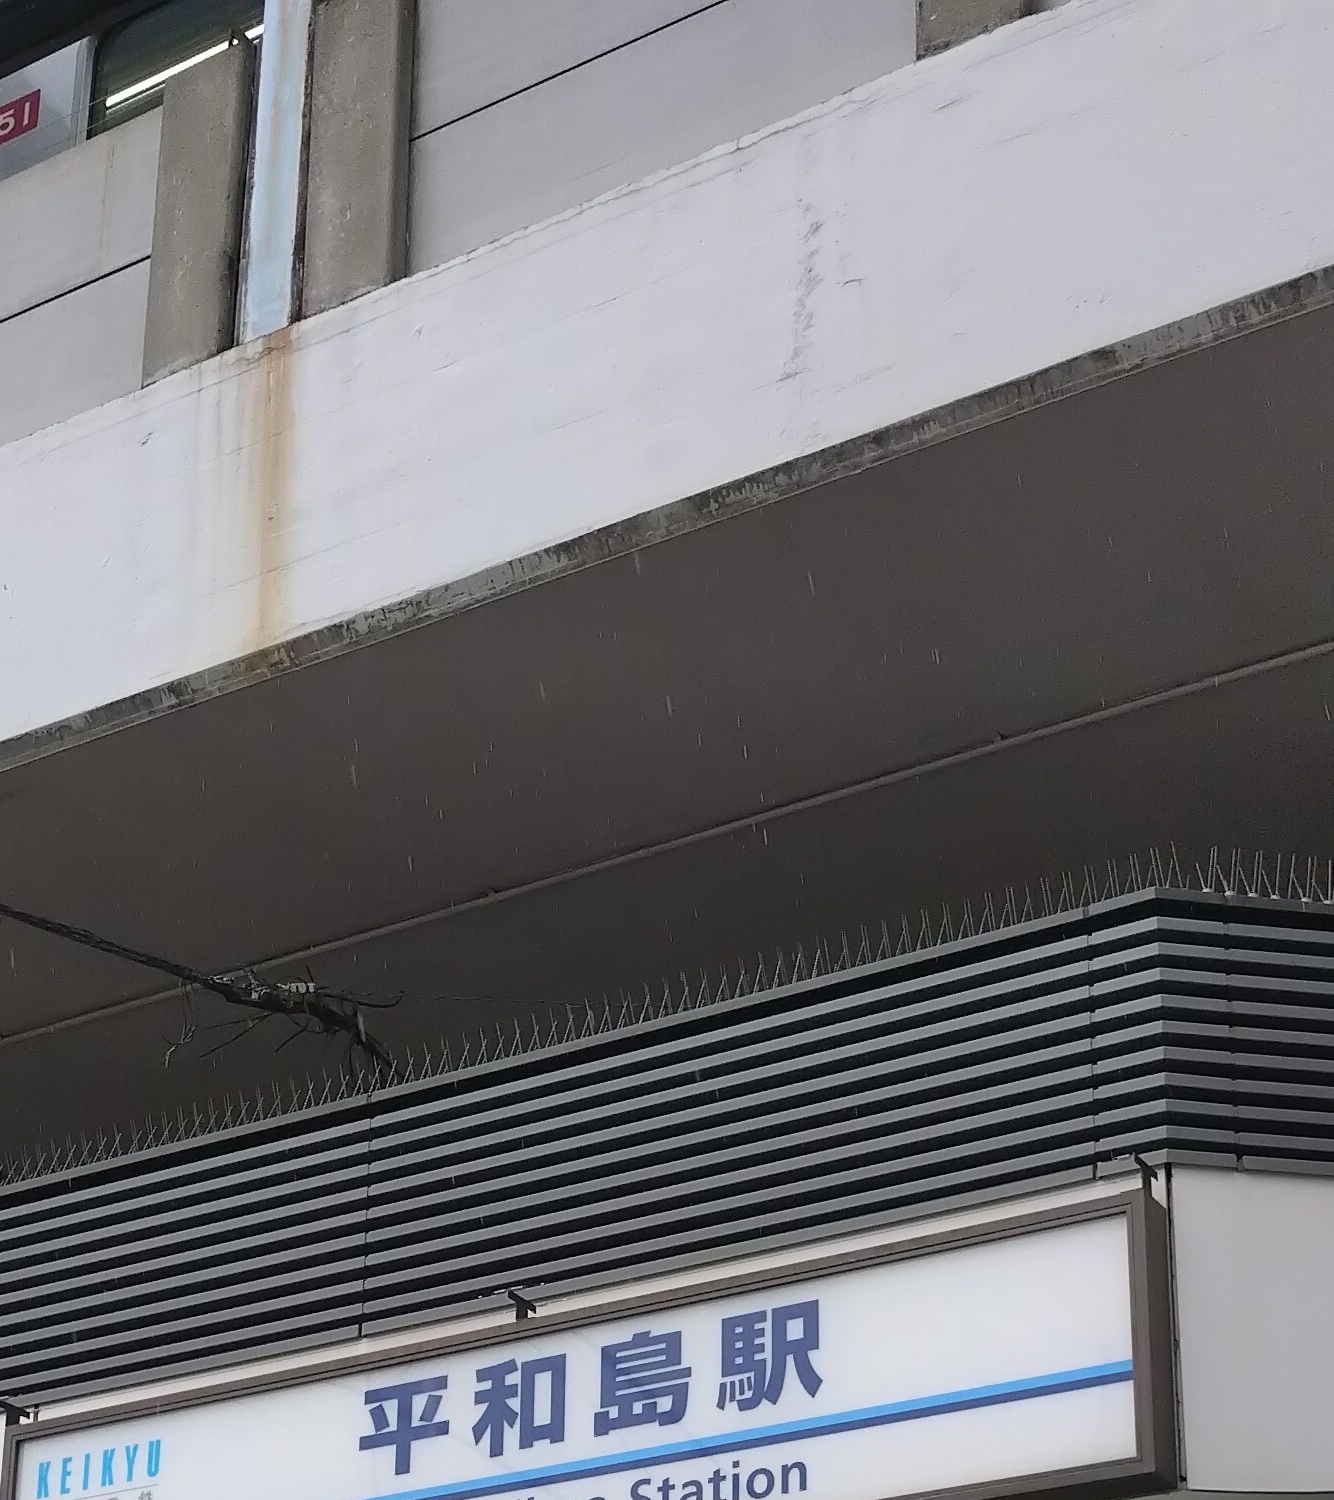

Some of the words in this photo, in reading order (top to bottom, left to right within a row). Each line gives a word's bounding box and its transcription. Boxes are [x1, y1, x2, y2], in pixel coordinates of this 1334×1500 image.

[357, 1299, 824, 1476] 平和島駅
[36, 1439, 162, 1500] KEIKYU
